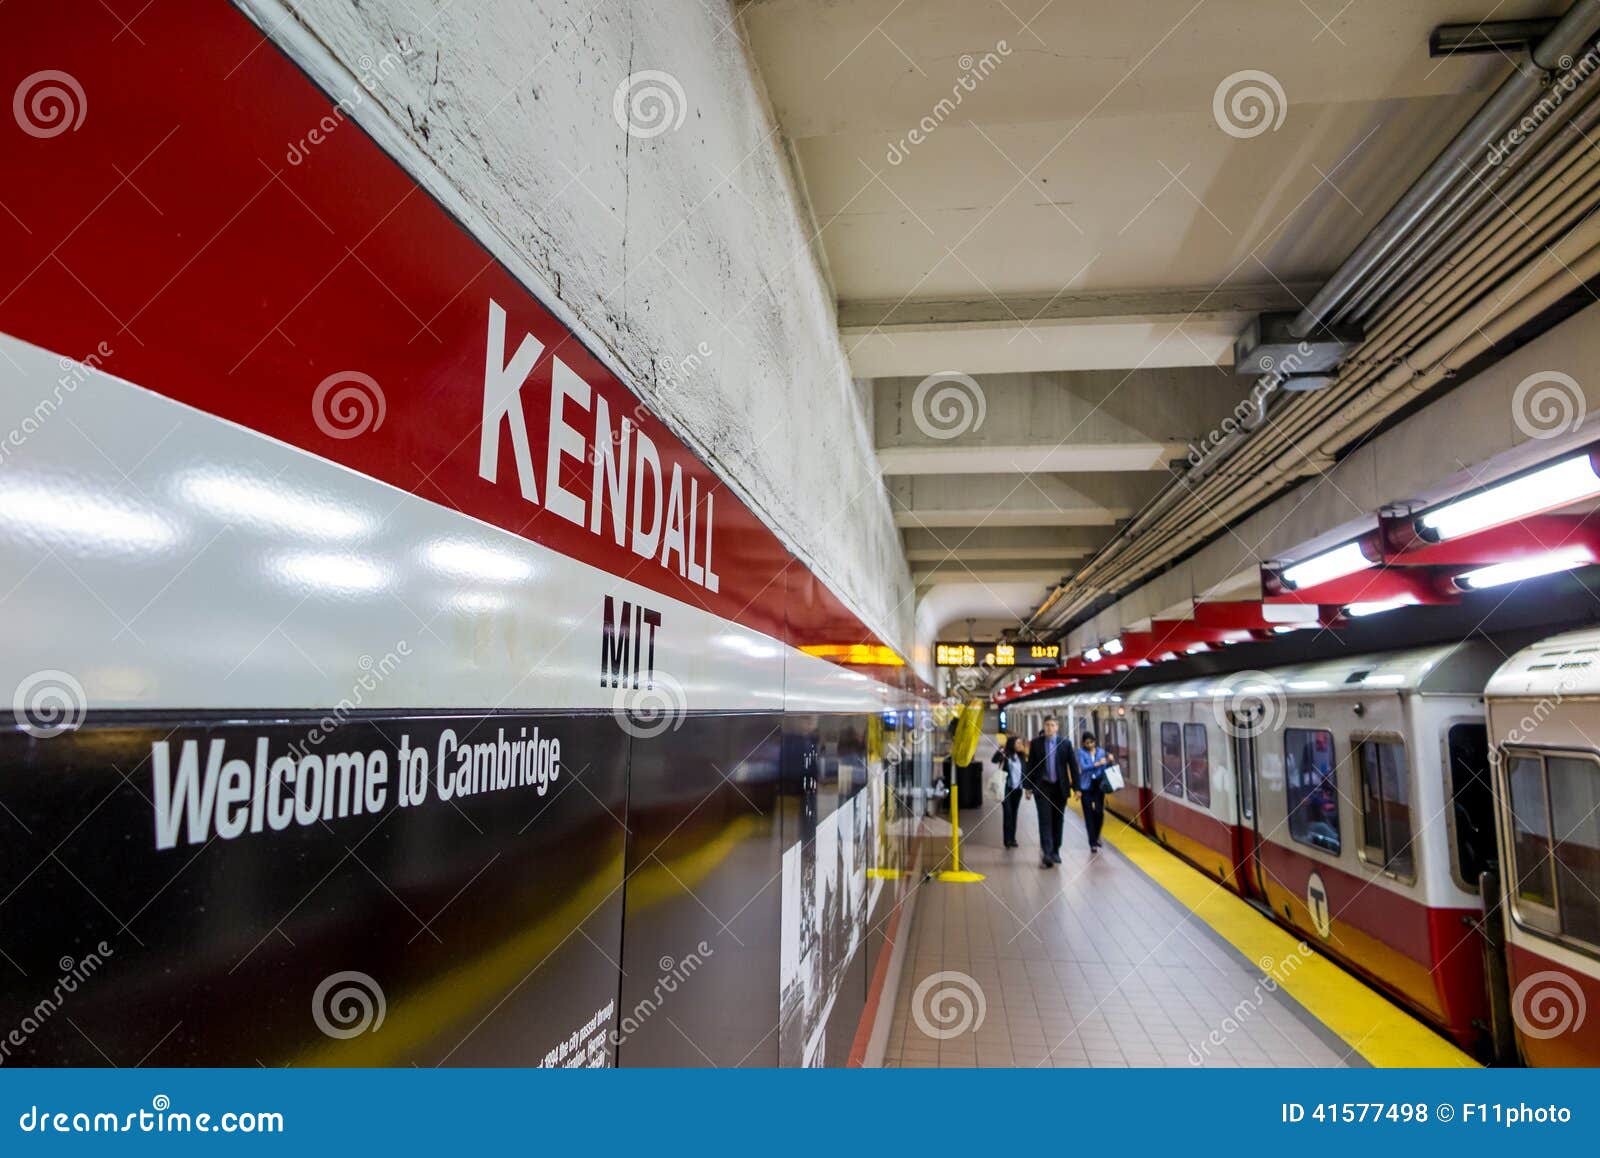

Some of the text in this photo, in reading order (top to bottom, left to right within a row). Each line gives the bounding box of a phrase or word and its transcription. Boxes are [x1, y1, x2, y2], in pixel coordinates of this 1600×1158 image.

[479, 297, 719, 594] KENDALL
[601, 594, 661, 690] MIT
[1031, 646, 1059, 657] 11:17
[152, 726, 561, 851] Welcome to Cambridge
[559, 1041, 569, 1062] the
[569, 1031, 580, 1053] city
[579, 1012, 598, 1047] passed
[597, 998, 614, 1027] through
